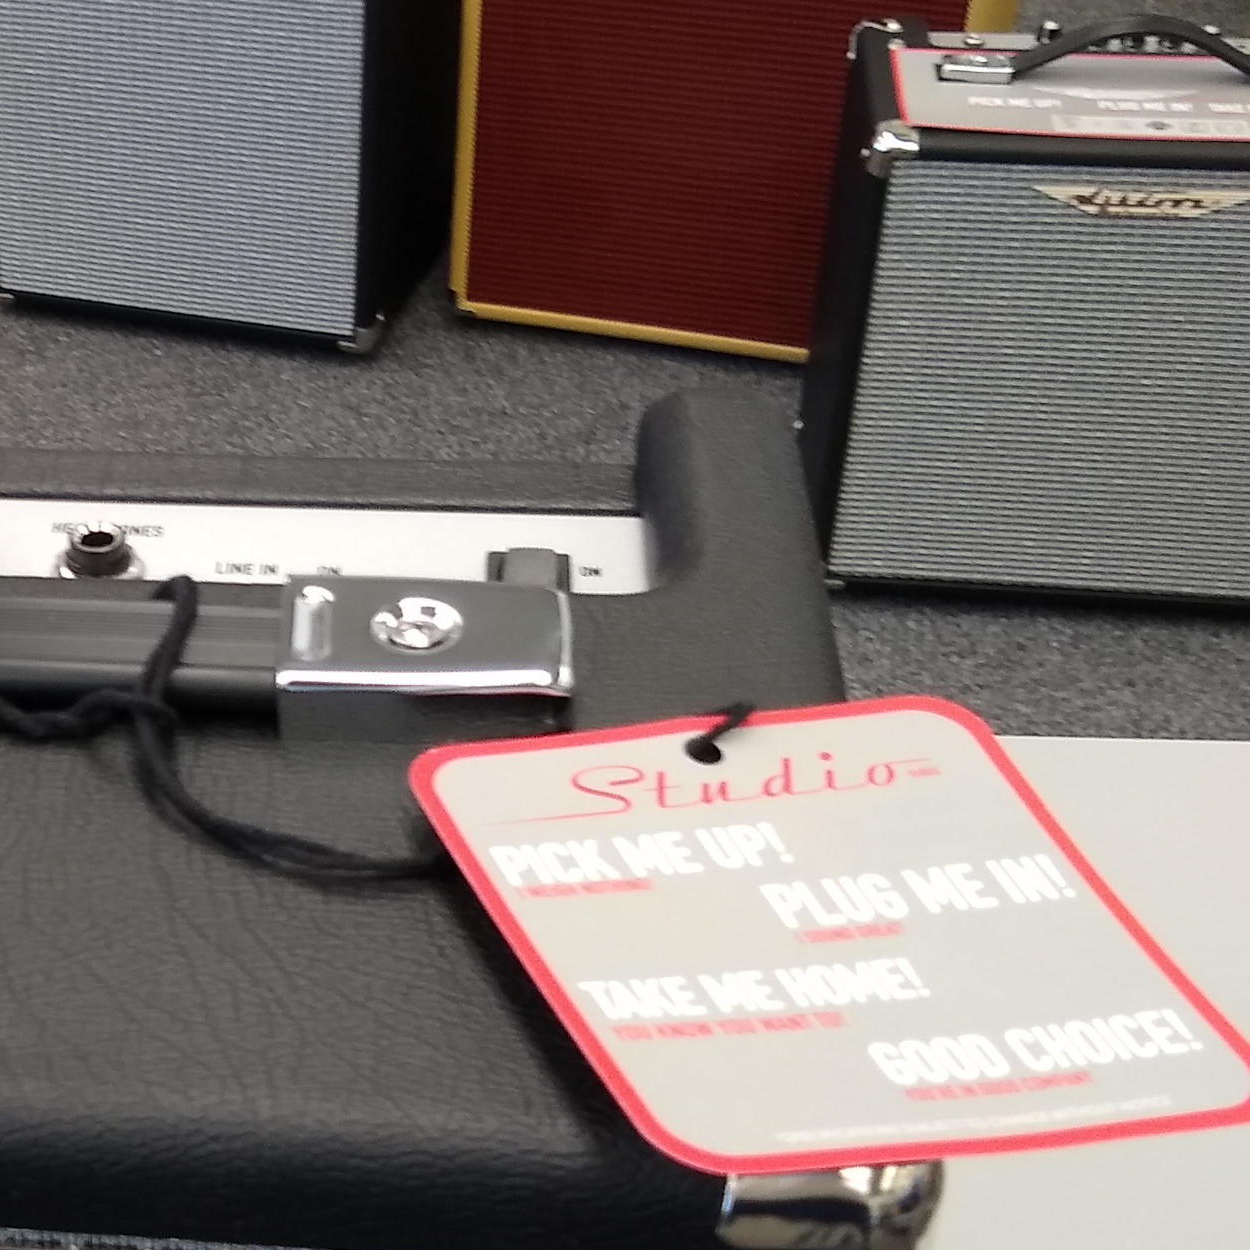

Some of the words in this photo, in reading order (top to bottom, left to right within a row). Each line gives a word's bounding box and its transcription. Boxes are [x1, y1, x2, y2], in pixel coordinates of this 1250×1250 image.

[214, 561, 254, 576] LINE
[258, 563, 280, 577] IN
[540, 750, 930, 820] Studio
[489, 839, 621, 887] PICK
[611, 831, 704, 878] ME
[694, 821, 795, 870] UP!
[758, 872, 910, 930] PLUG
[901, 863, 1000, 915] ME
[985, 853, 1078, 904] IN!
[576, 976, 708, 1021] TAKE
[697, 970, 785, 1014] ME
[773, 957, 932, 1008] HOME!
[867, 1033, 1011, 1086] GOOD
[1003, 1009, 1204, 1073] CHOICE!
